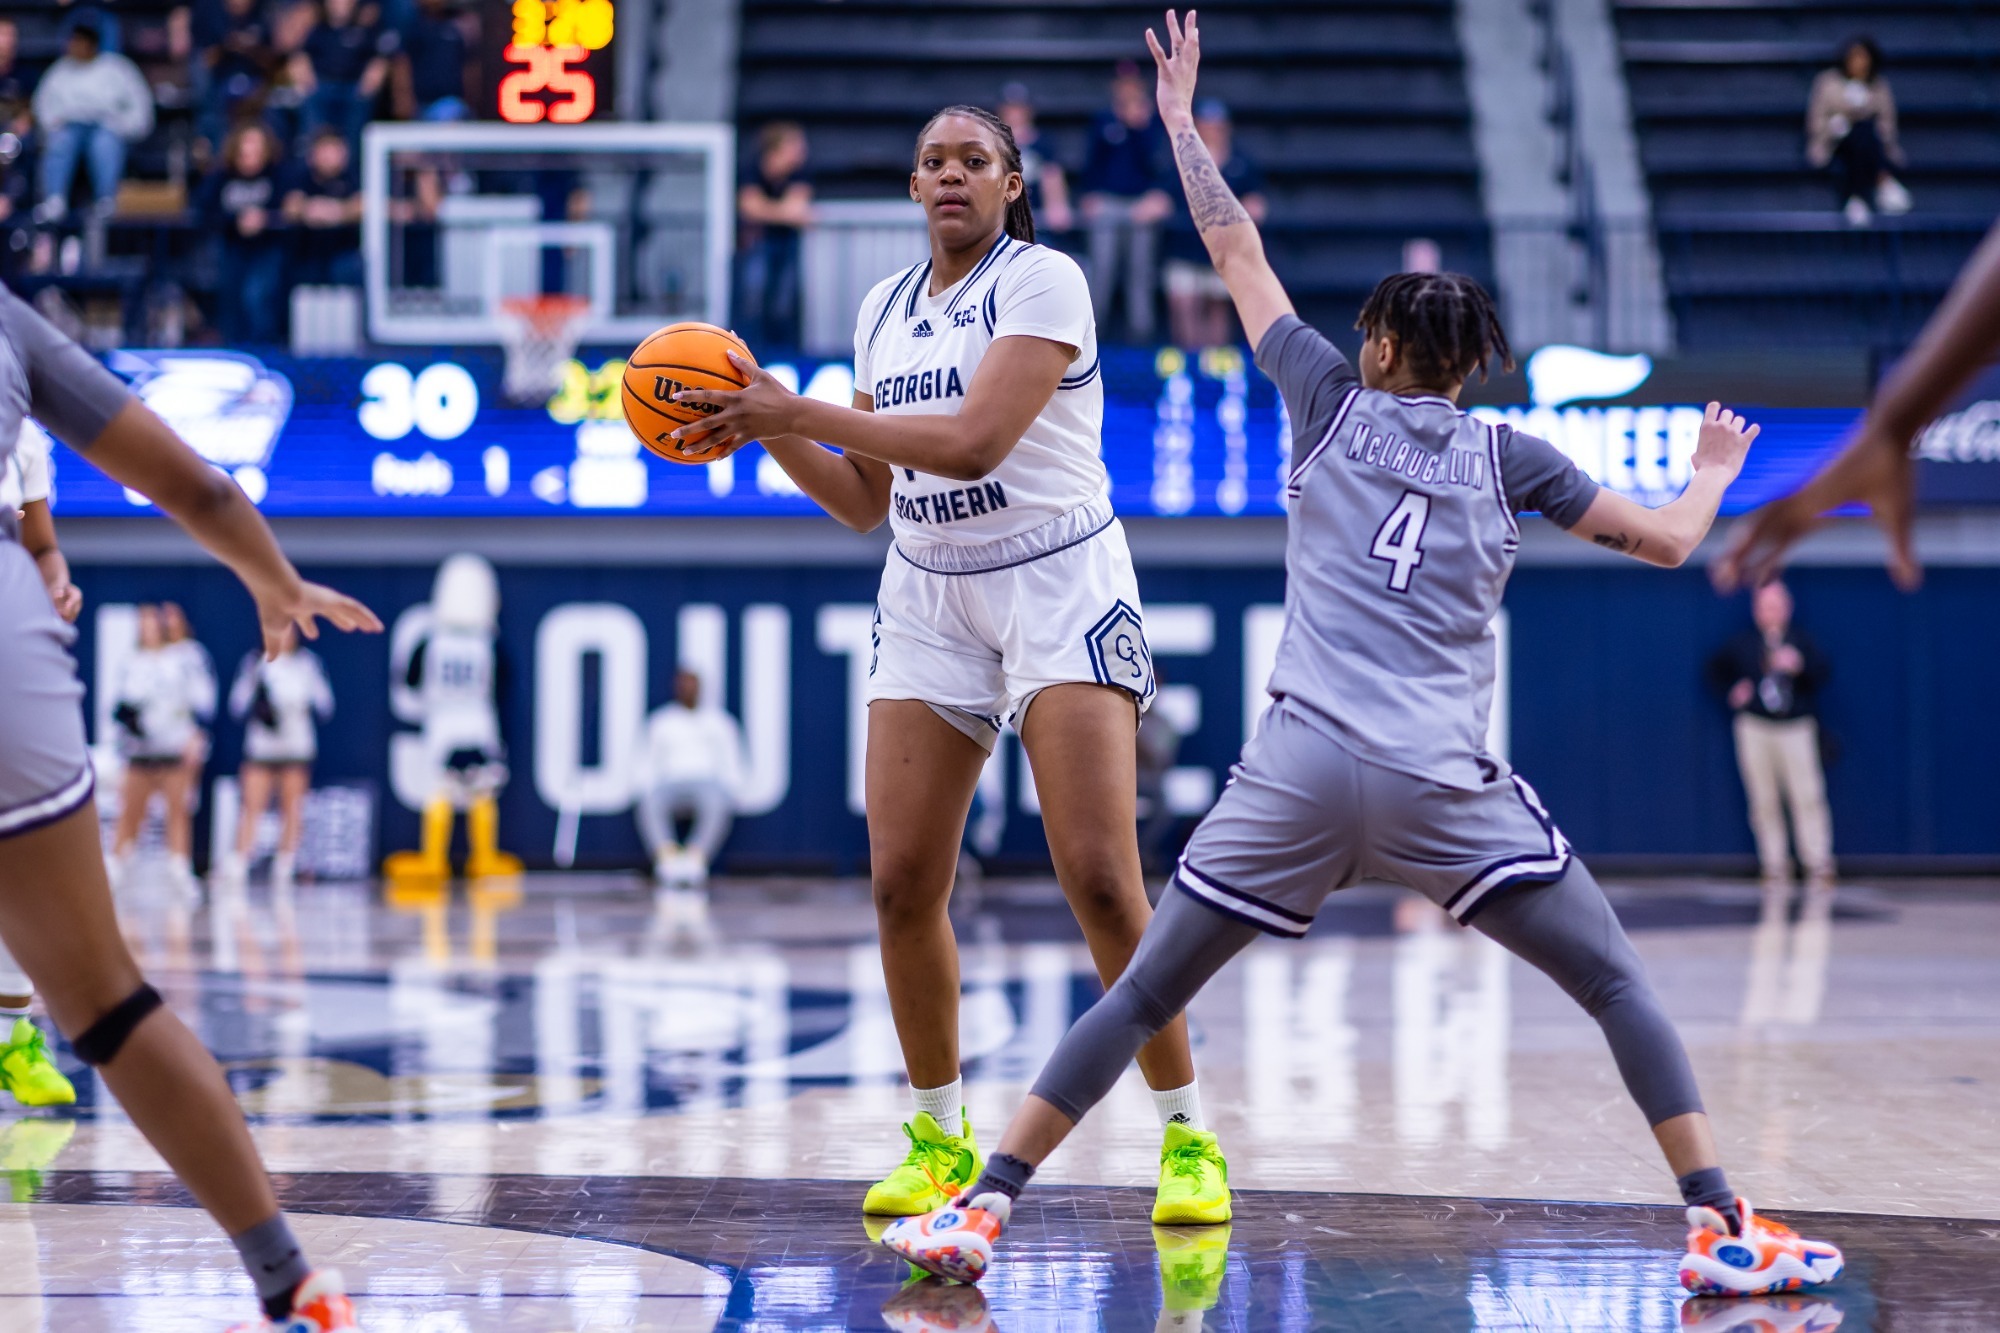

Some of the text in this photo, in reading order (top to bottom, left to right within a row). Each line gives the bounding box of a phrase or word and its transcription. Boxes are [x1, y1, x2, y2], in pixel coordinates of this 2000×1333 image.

[498, 44, 596, 124] 25
[358, 362, 478, 440] 30
[875, 366, 964, 410] GEORGIA
[1369, 488, 1431, 594] 4
